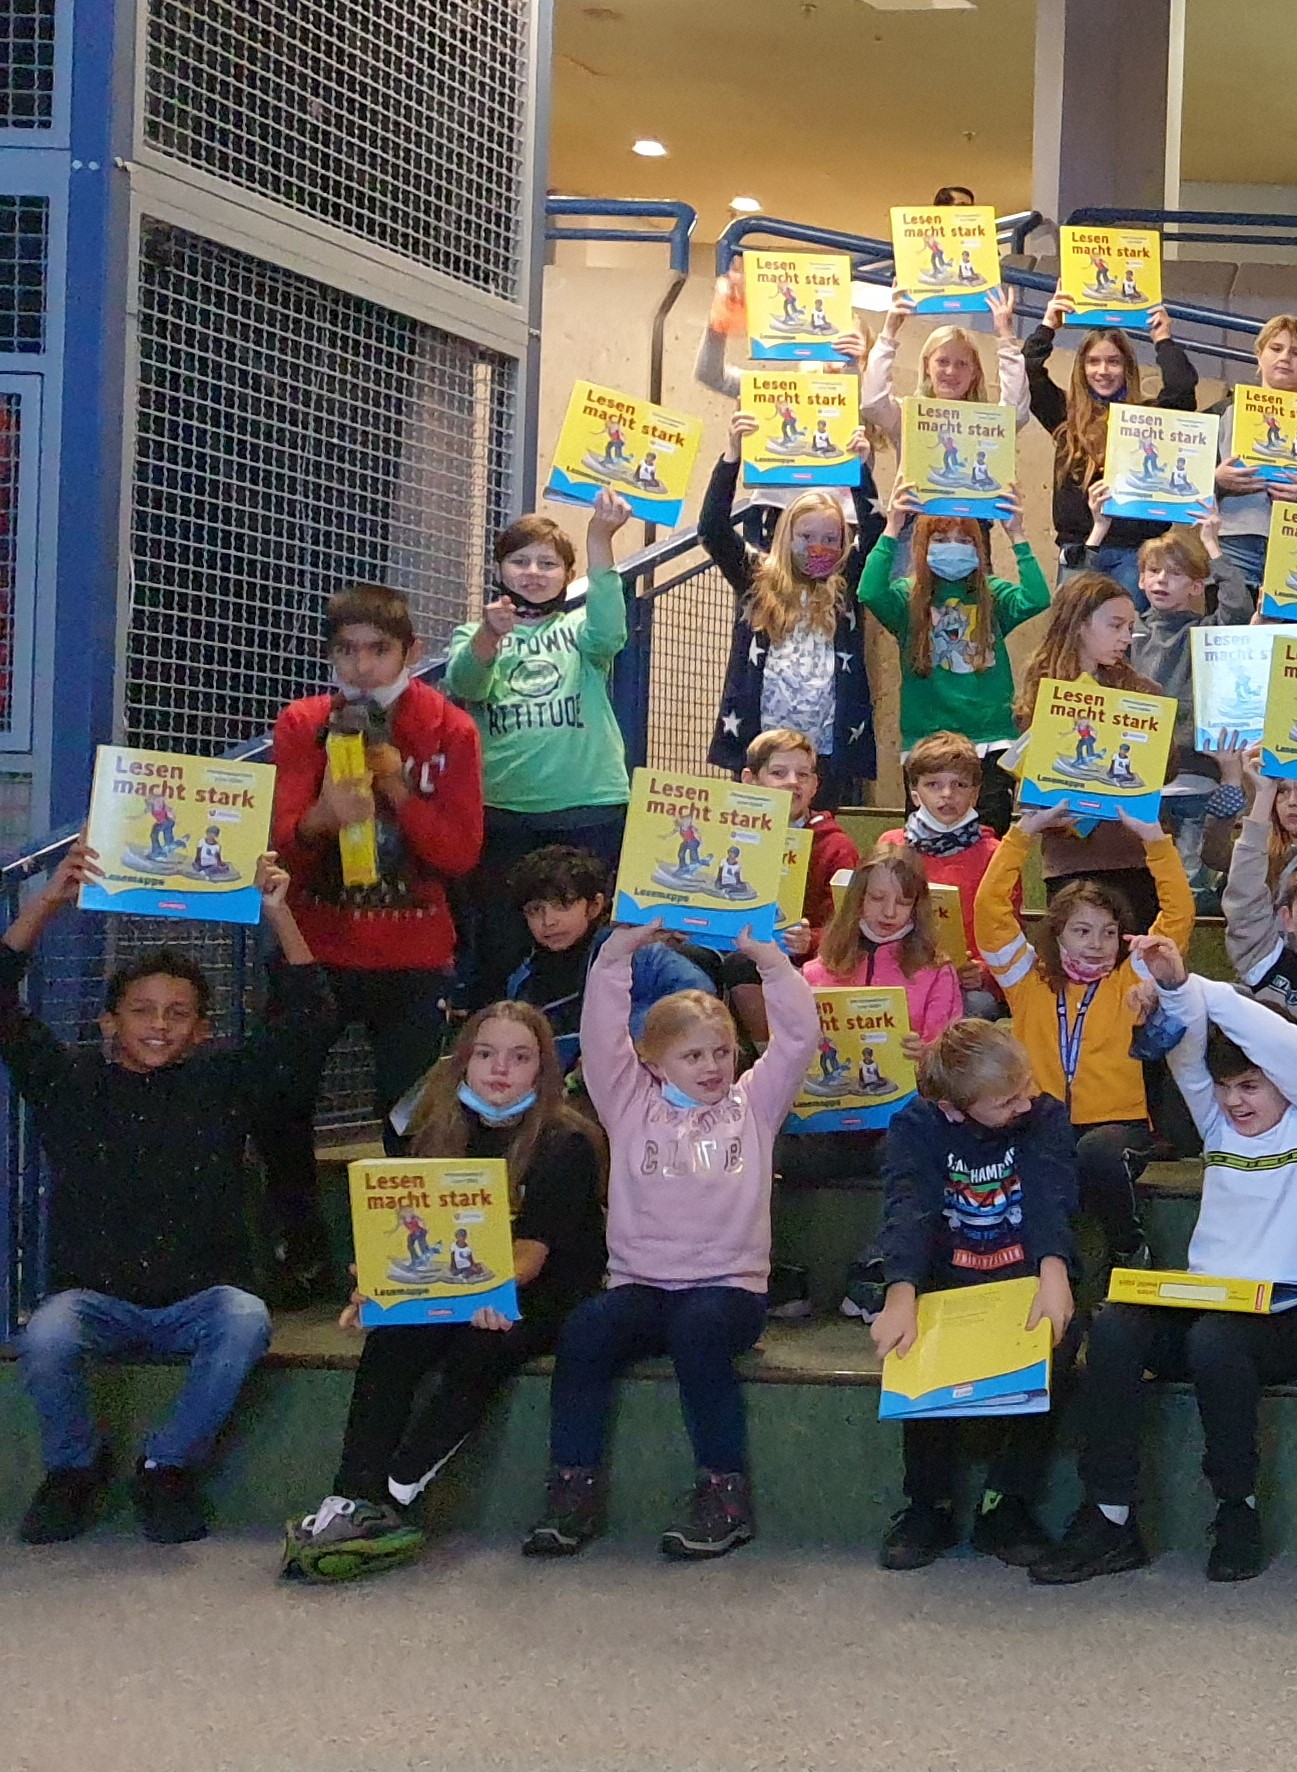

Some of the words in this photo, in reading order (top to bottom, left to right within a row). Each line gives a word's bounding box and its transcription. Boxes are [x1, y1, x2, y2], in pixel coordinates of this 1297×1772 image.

[903, 214, 942, 225] Lesen
[904, 226, 946, 238] macht
[951, 226, 985, 237] stark
[1072, 233, 1109, 244] Lesen
[1072, 244, 1112, 258] macht
[1118, 246, 1150, 258] stark
[757, 258, 796, 271] Lesen
[757, 272, 799, 285] macht
[805, 274, 840, 286] stark
[753, 378, 797, 390] Lesen
[586, 389, 636, 415] Lesen
[753, 393, 799, 405] macht
[807, 394, 846, 406] stark
[1246, 391, 1283, 405] Lesen
[918, 405, 960, 420] Lesen
[1245, 402, 1284, 416] macht
[582, 403, 636, 432] macht
[641, 424, 684, 447] stark
[1121, 411, 1162, 427] Lesen
[918, 420, 962, 435] macht
[968, 423, 1005, 438] stark
[1120, 425, 1164, 441] macht
[1170, 430, 1206, 445] stark
[500, 626, 579, 655] PTOWN
[1053, 687, 1105, 706] Lesen
[487, 694, 584, 736] ATTITUDE
[1050, 702, 1105, 723] macht
[1112, 714, 1159, 731] stark
[115, 756, 183, 780] Lesen
[113, 777, 186, 800] macht
[195, 788, 254, 808] stark
[649, 778, 709, 802] Lesen
[646, 798, 711, 821] macht
[719, 809, 772, 830] stark
[847, 1014, 894, 1030] stark
[365, 1172, 425, 1191] Lesen
[368, 1192, 433, 1211] macht
[439, 1188, 492, 1208] stark
